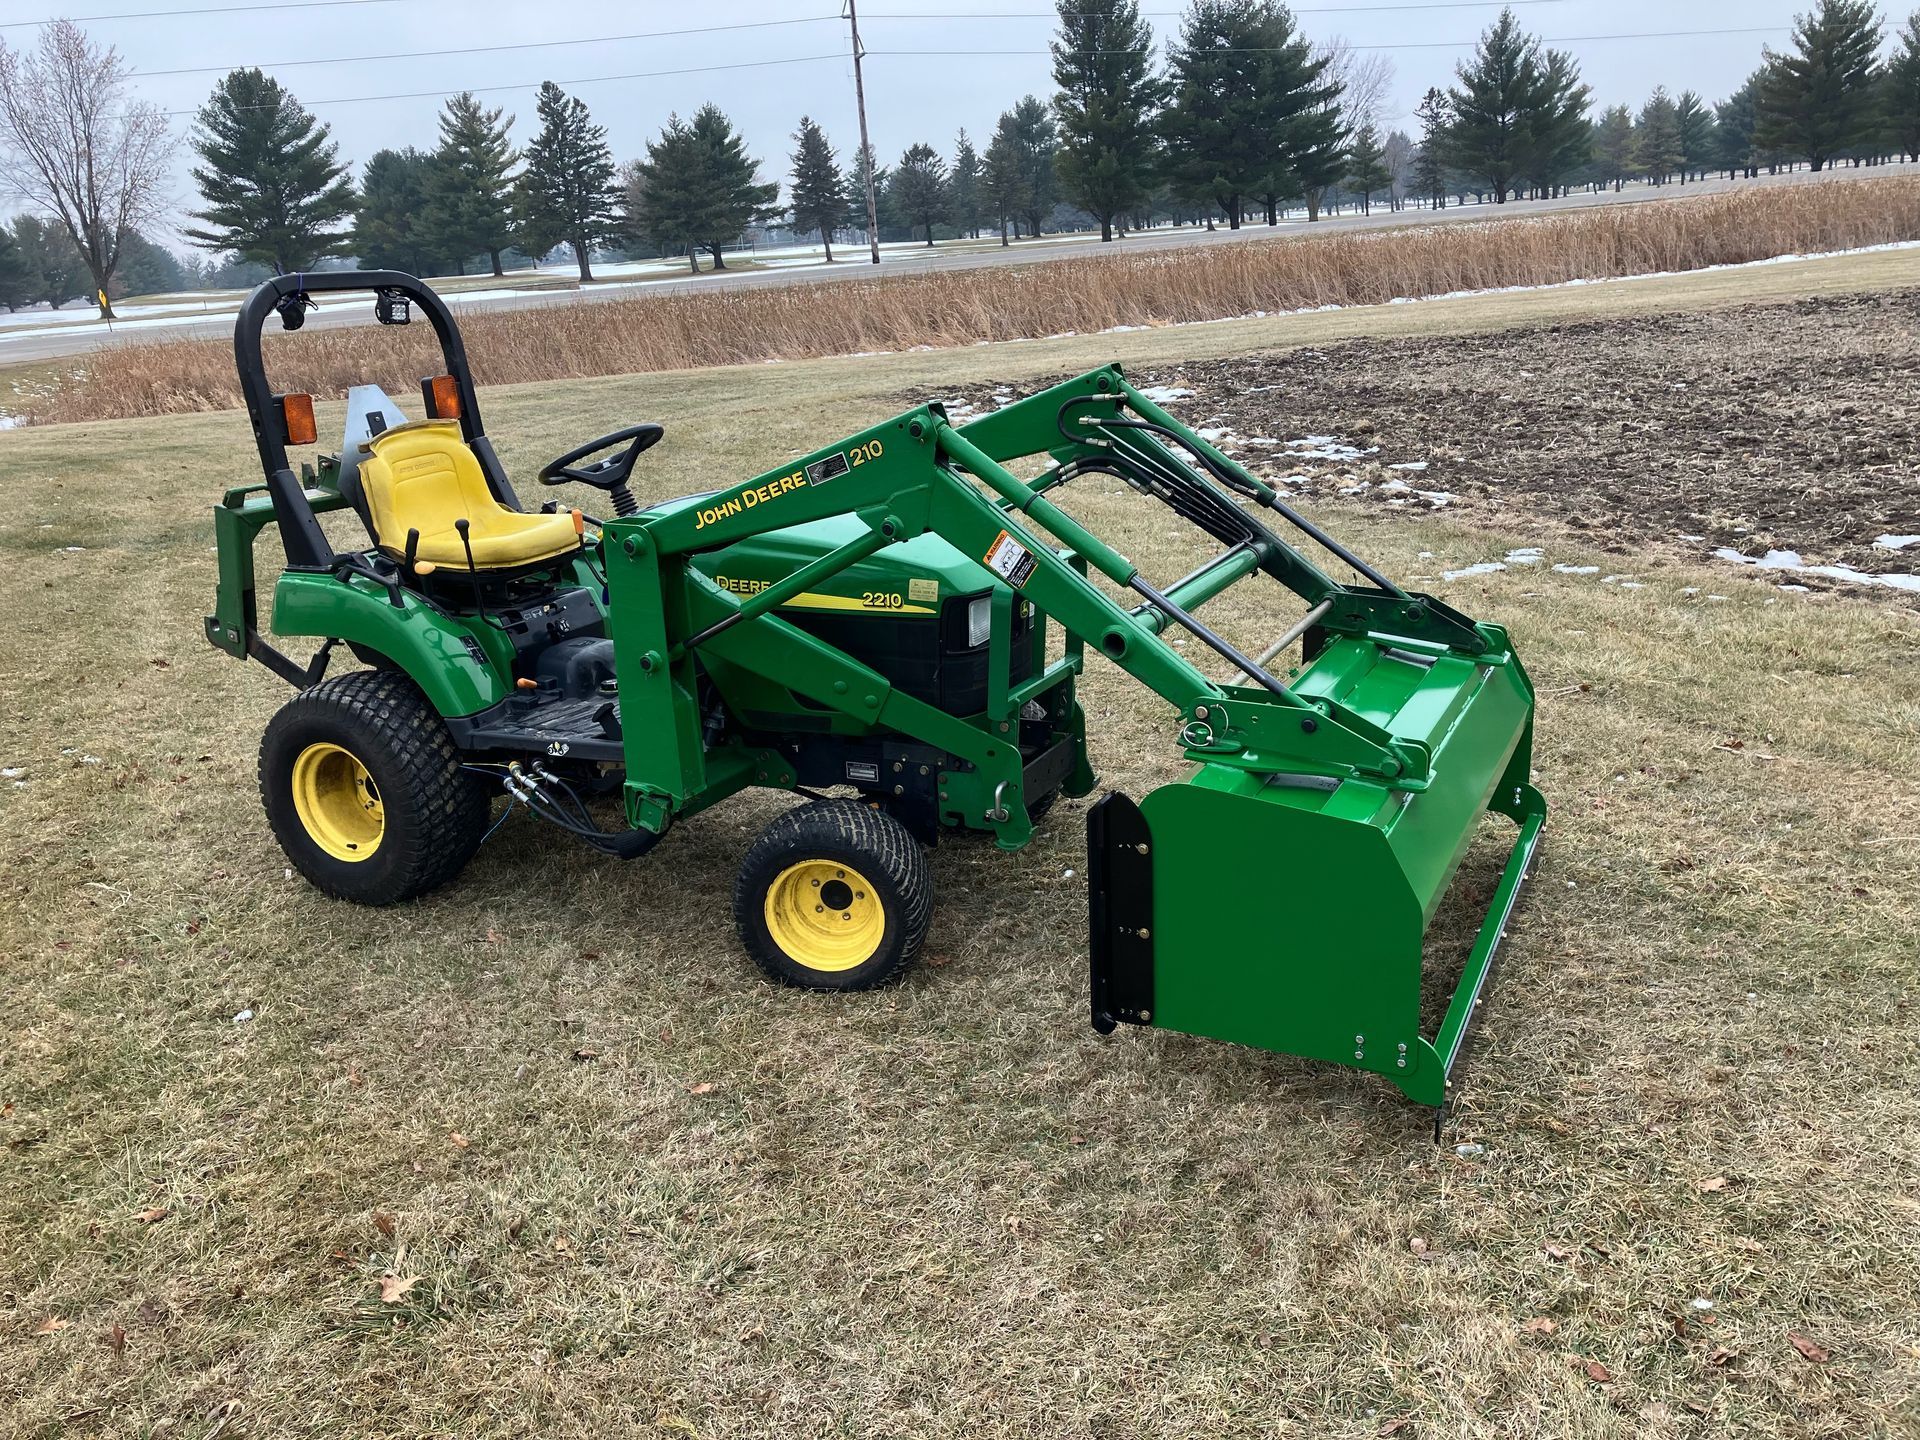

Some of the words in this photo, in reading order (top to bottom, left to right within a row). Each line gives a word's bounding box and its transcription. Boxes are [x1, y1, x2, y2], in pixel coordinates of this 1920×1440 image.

[695, 498, 742, 530] JOHN
[742, 471, 807, 509] DEERE
[849, 439, 884, 467] 210
[862, 592, 904, 609] 2210
